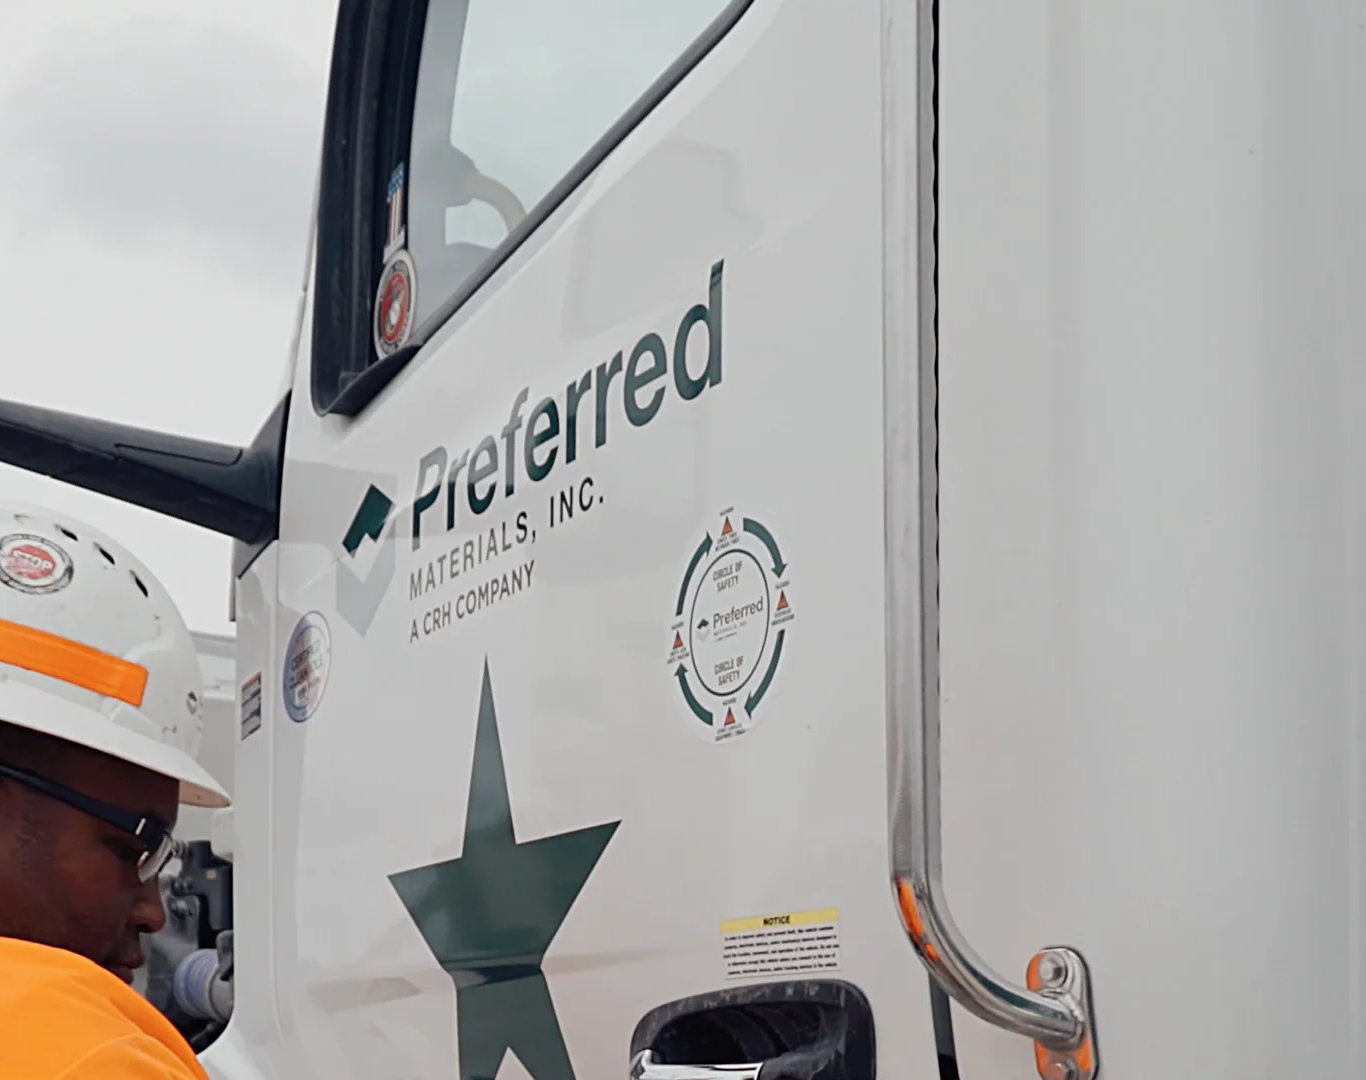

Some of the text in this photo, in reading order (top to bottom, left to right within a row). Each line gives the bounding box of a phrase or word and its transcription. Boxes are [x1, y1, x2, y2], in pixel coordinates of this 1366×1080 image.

[411, 258, 724, 551] Preferred
[409, 477, 605, 601] MATERIALS, INC.
[712, 560, 743, 582] CIRCLE OF
[716, 575, 740, 593] SAFETY
[409, 559, 535, 644] A CRH COMPANY
[713, 596, 764, 629] Preferred
[714, 656, 744, 676] CIRCLE OF
[717, 670, 741, 686] SAFETY
[763, 915, 791, 926] NOTICE
